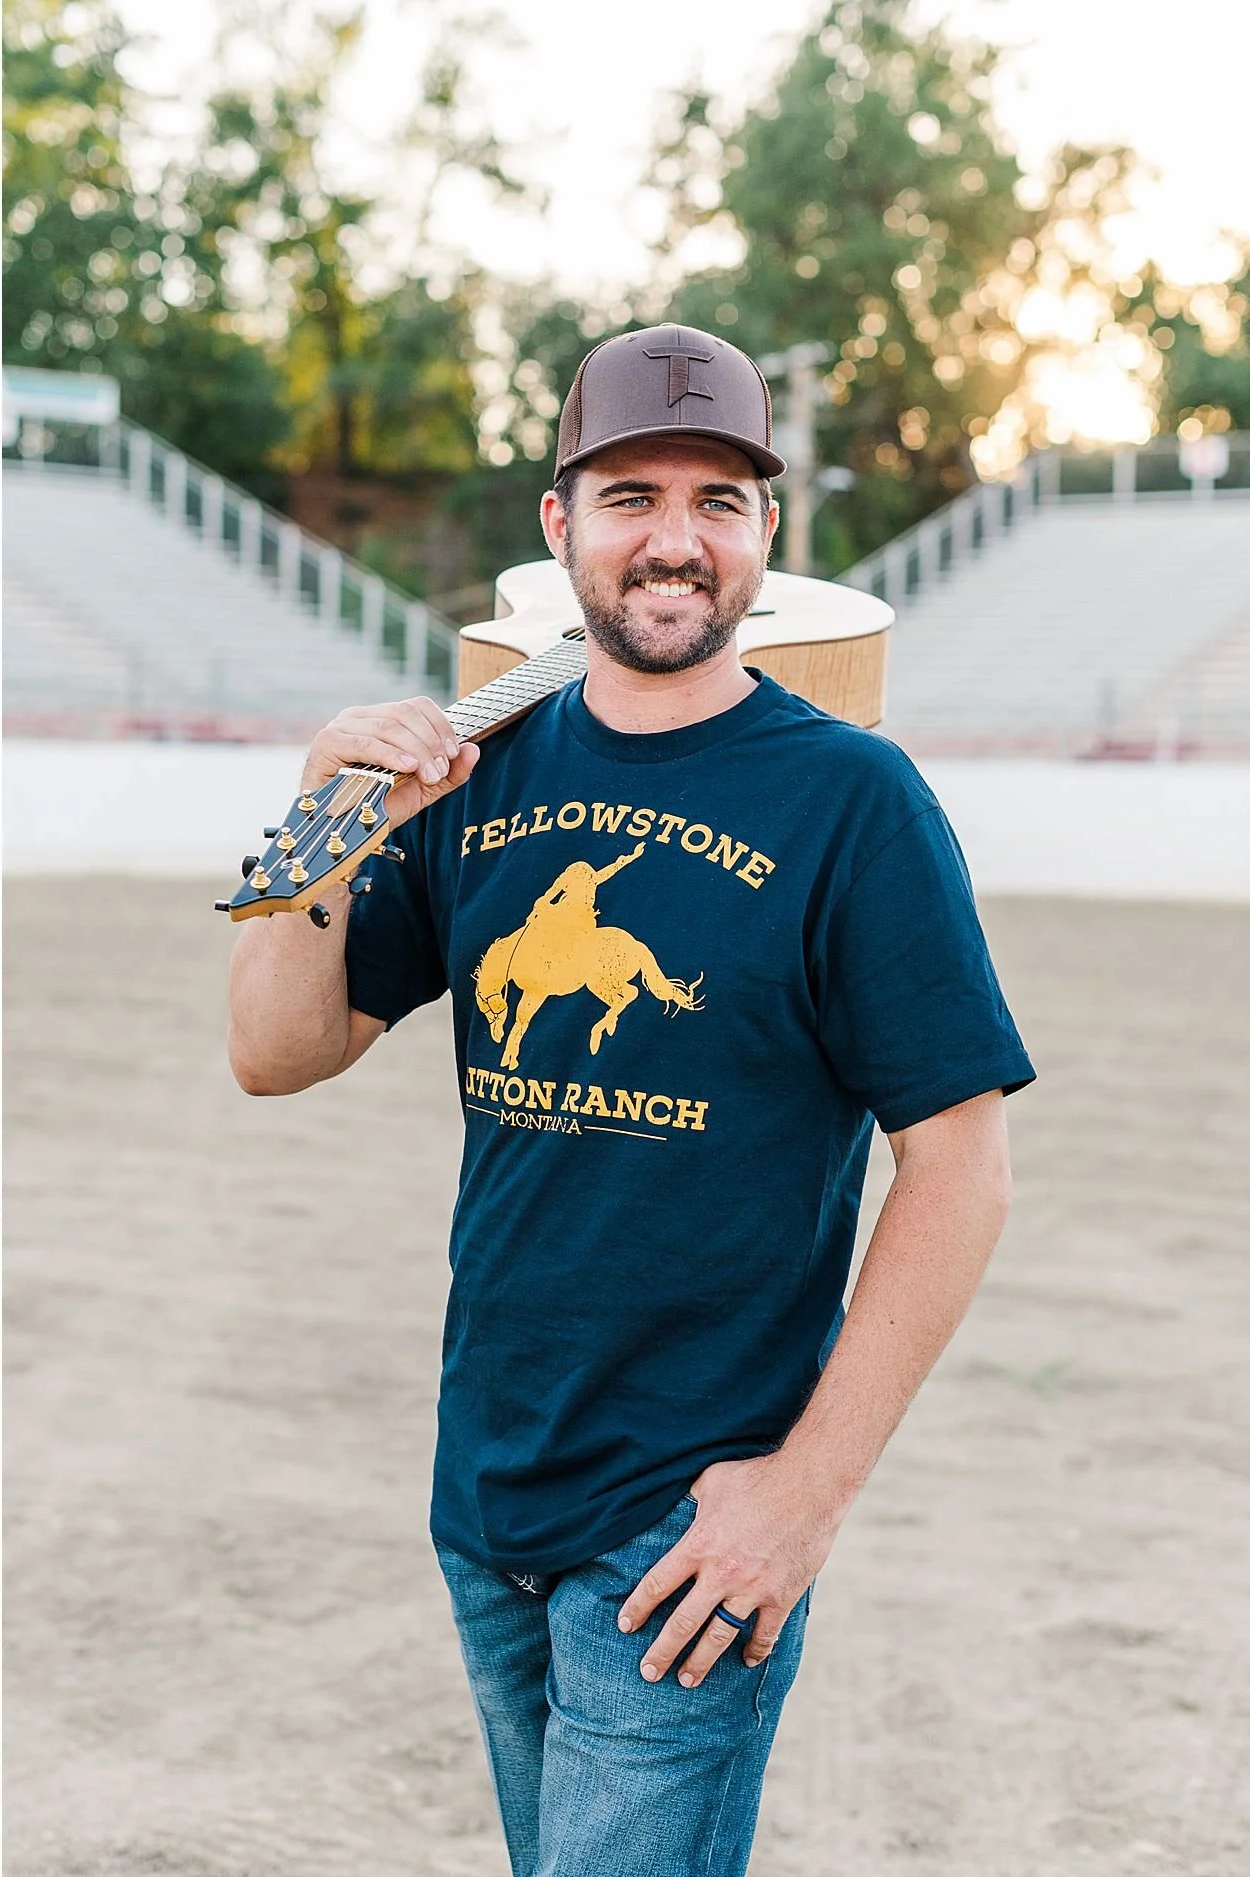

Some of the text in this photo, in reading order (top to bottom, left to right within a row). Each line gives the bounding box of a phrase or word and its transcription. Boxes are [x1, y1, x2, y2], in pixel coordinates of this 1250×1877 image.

[461, 801, 777, 890] YELLOWSTONE
[465, 1066, 710, 1131] UTTON RANCH
